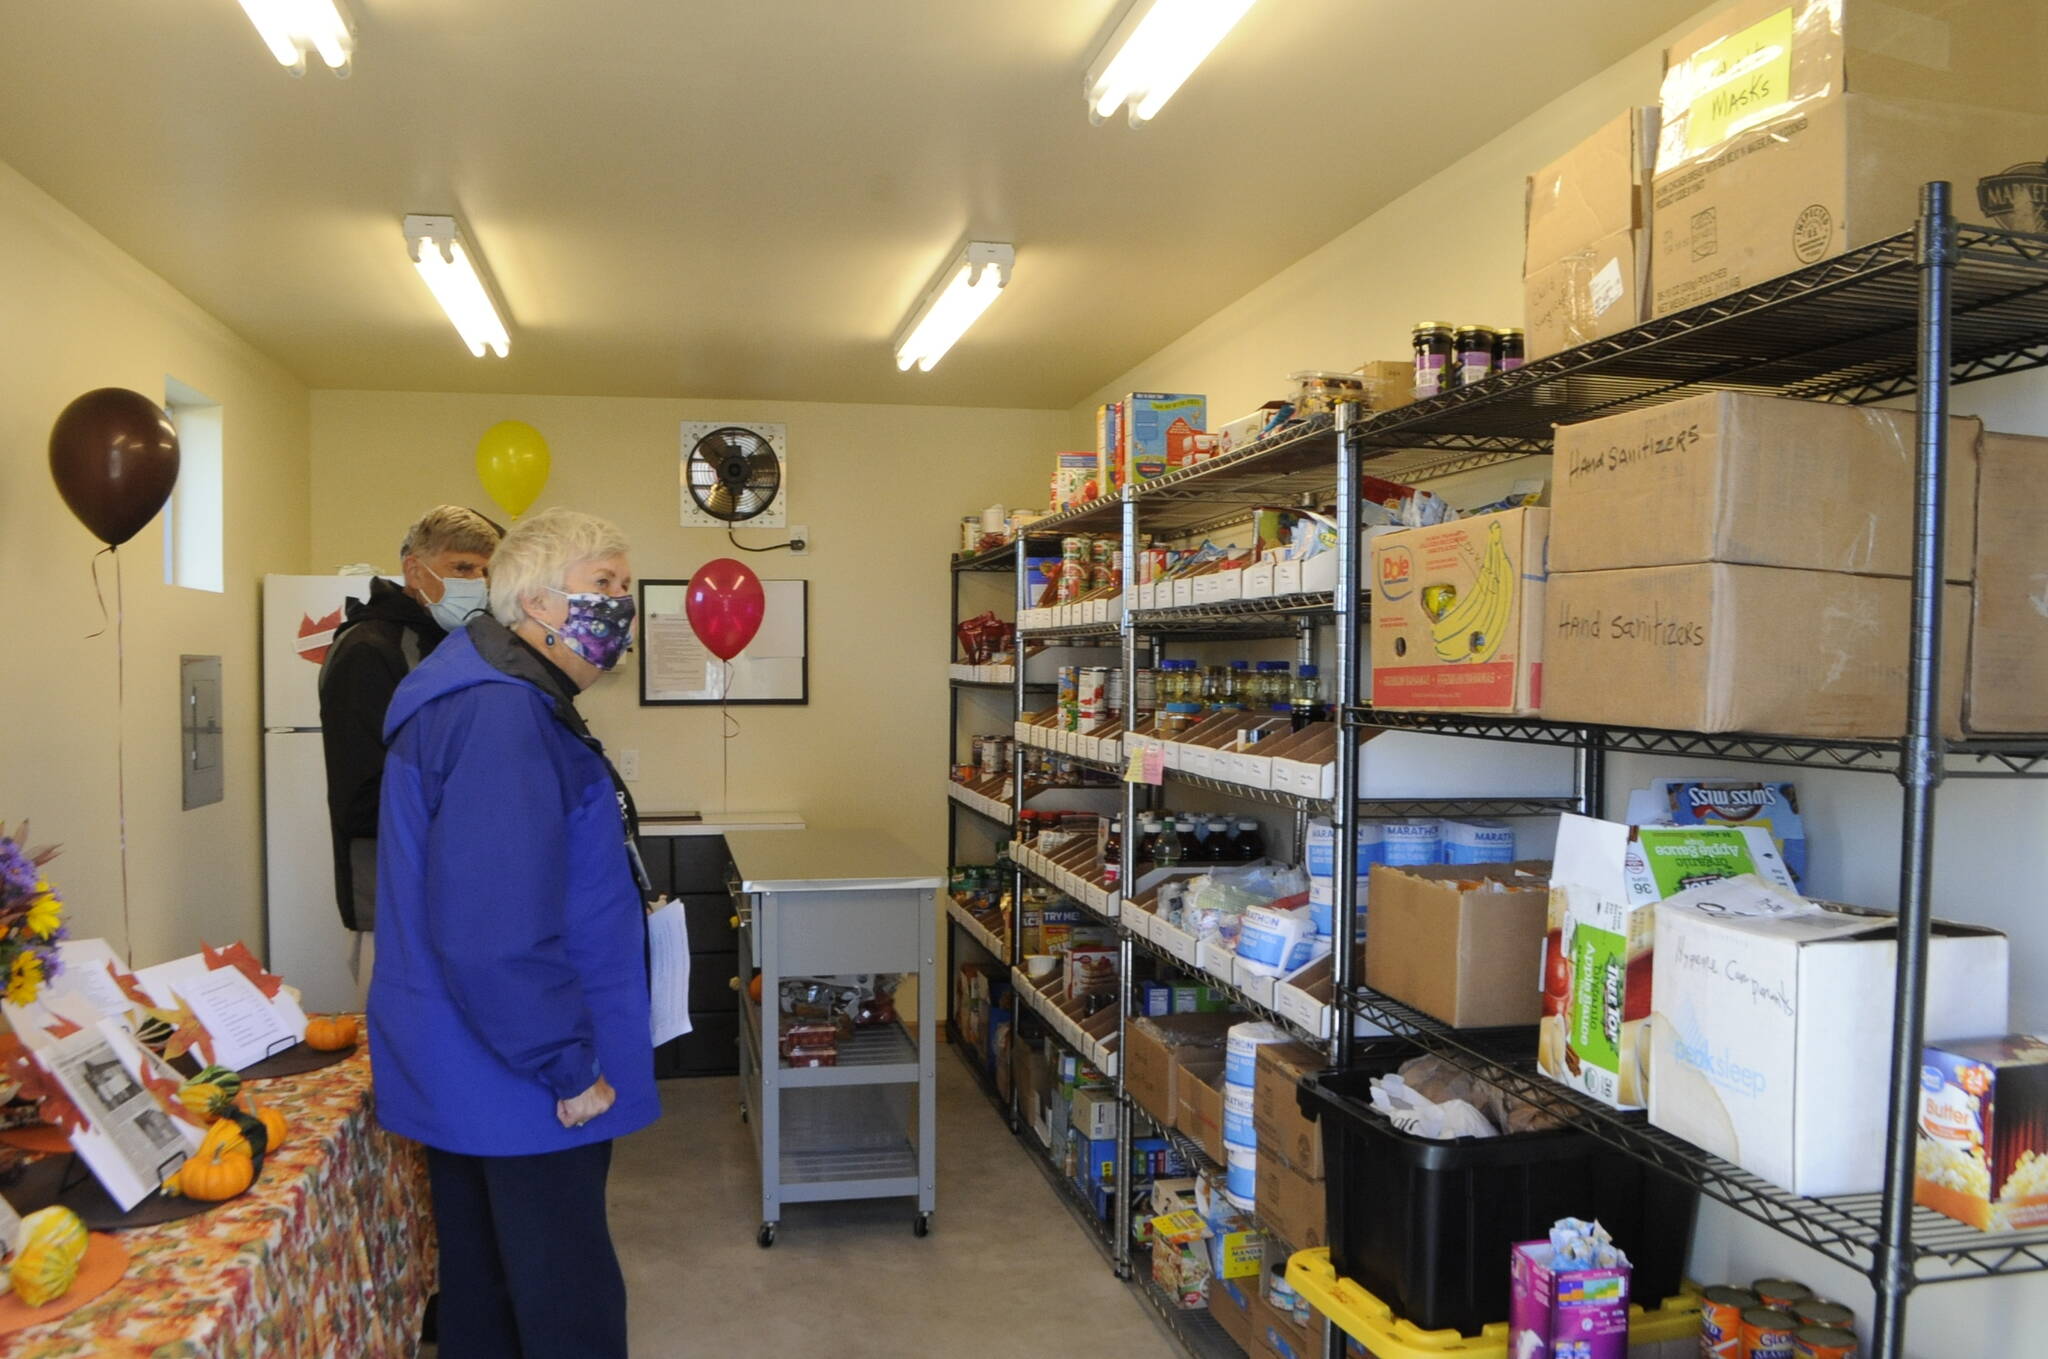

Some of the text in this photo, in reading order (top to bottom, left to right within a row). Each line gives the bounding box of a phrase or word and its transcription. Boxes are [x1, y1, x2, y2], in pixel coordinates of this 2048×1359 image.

[1383, 555, 1410, 580] Dole
[1656, 845, 1739, 858] Apple Sauce
[1634, 883, 1652, 894] 36
[1044, 911, 1063, 921] TRY
[1580, 941, 1596, 1046] Apple Sauce
[1604, 1007, 1620, 1045] TOP
[1926, 1097, 1969, 1125] Butter
